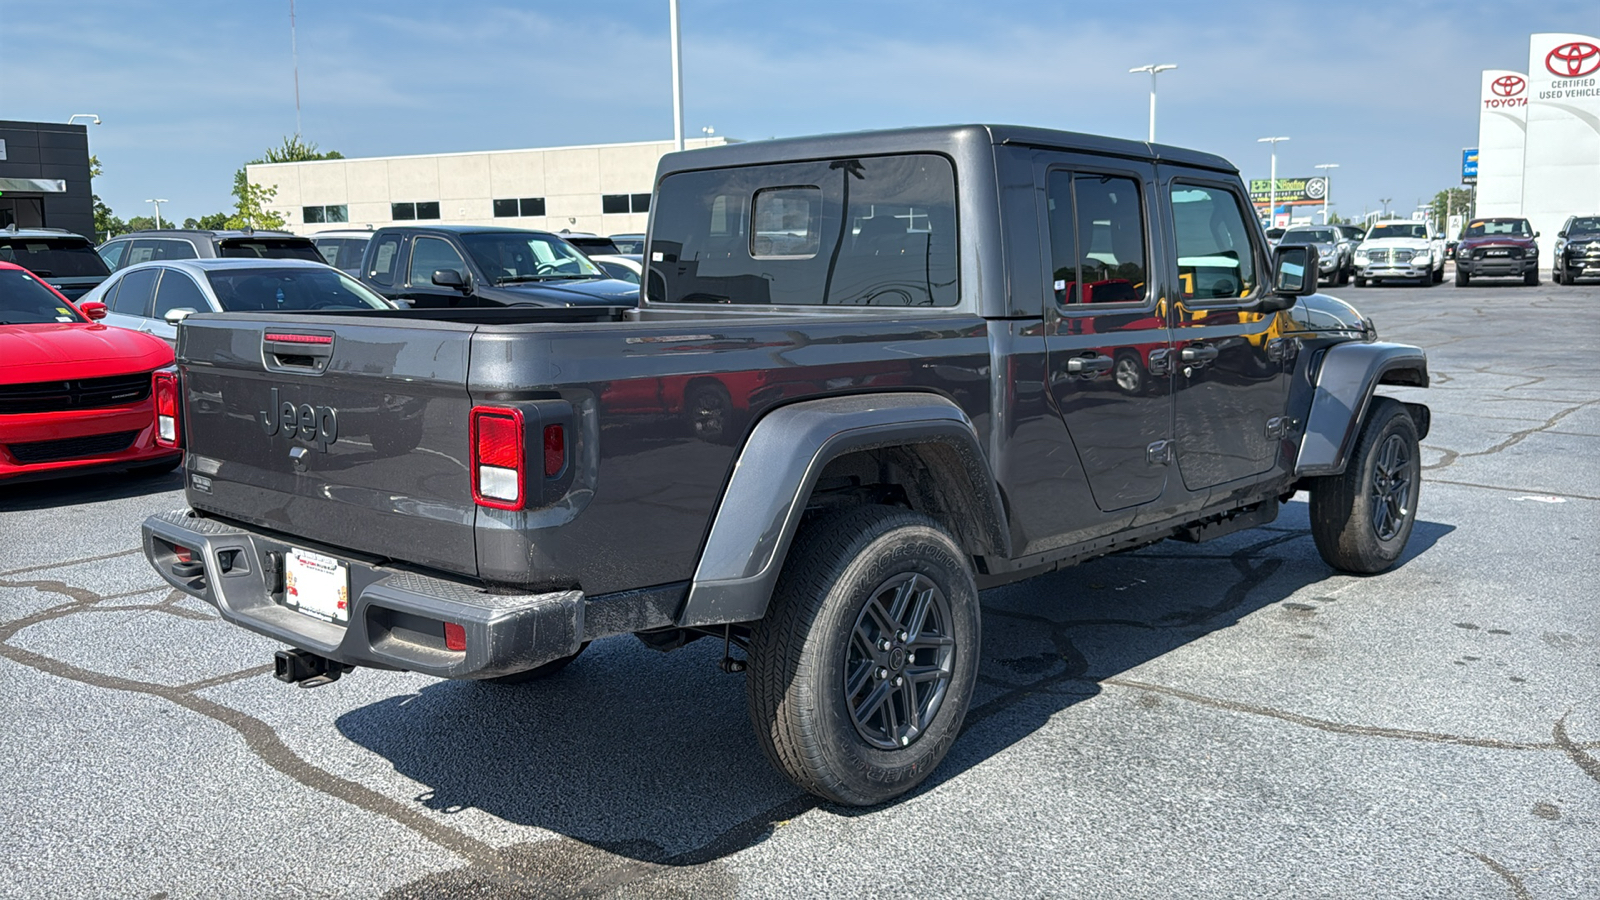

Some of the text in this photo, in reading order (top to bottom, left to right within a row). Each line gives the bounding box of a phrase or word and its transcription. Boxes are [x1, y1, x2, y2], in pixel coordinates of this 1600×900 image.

[1551, 78, 1596, 89] CERTIFIED
[1539, 90, 1563, 99] USED
[1484, 97, 1528, 108] TOYOTA
[259, 387, 339, 454] Jeep
[837, 541, 961, 634] BRIDGESTONE
